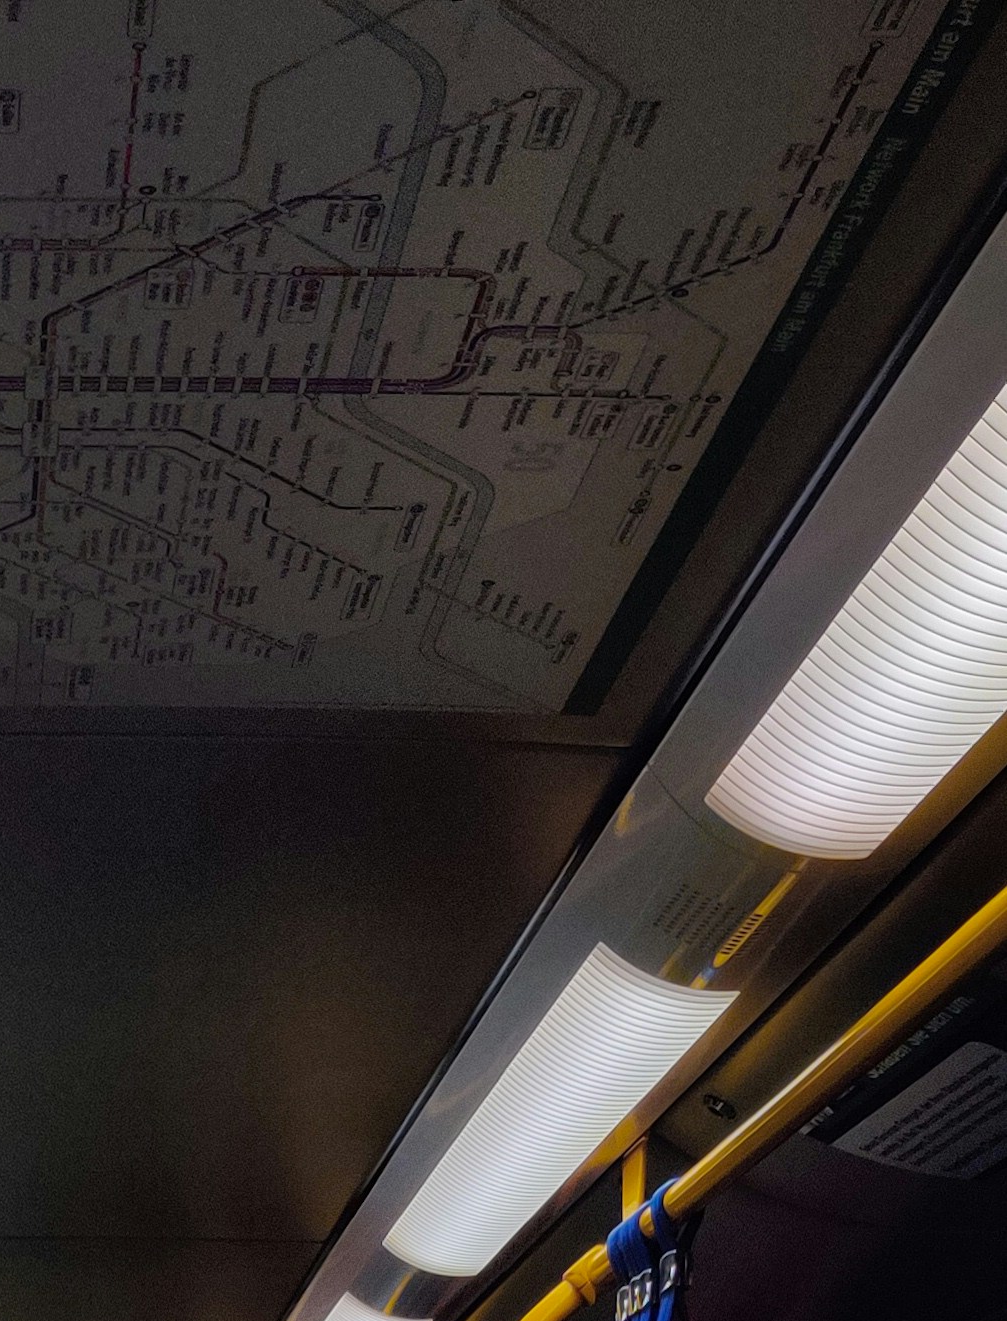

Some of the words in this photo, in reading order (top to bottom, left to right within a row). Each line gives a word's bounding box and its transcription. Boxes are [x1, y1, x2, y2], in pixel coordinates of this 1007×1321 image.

[931, 31, 960, 62] am
[902, 68, 945, 115] Main
[854, 137, 906, 208] Network
[812, 213, 862, 287] Frankfurt
